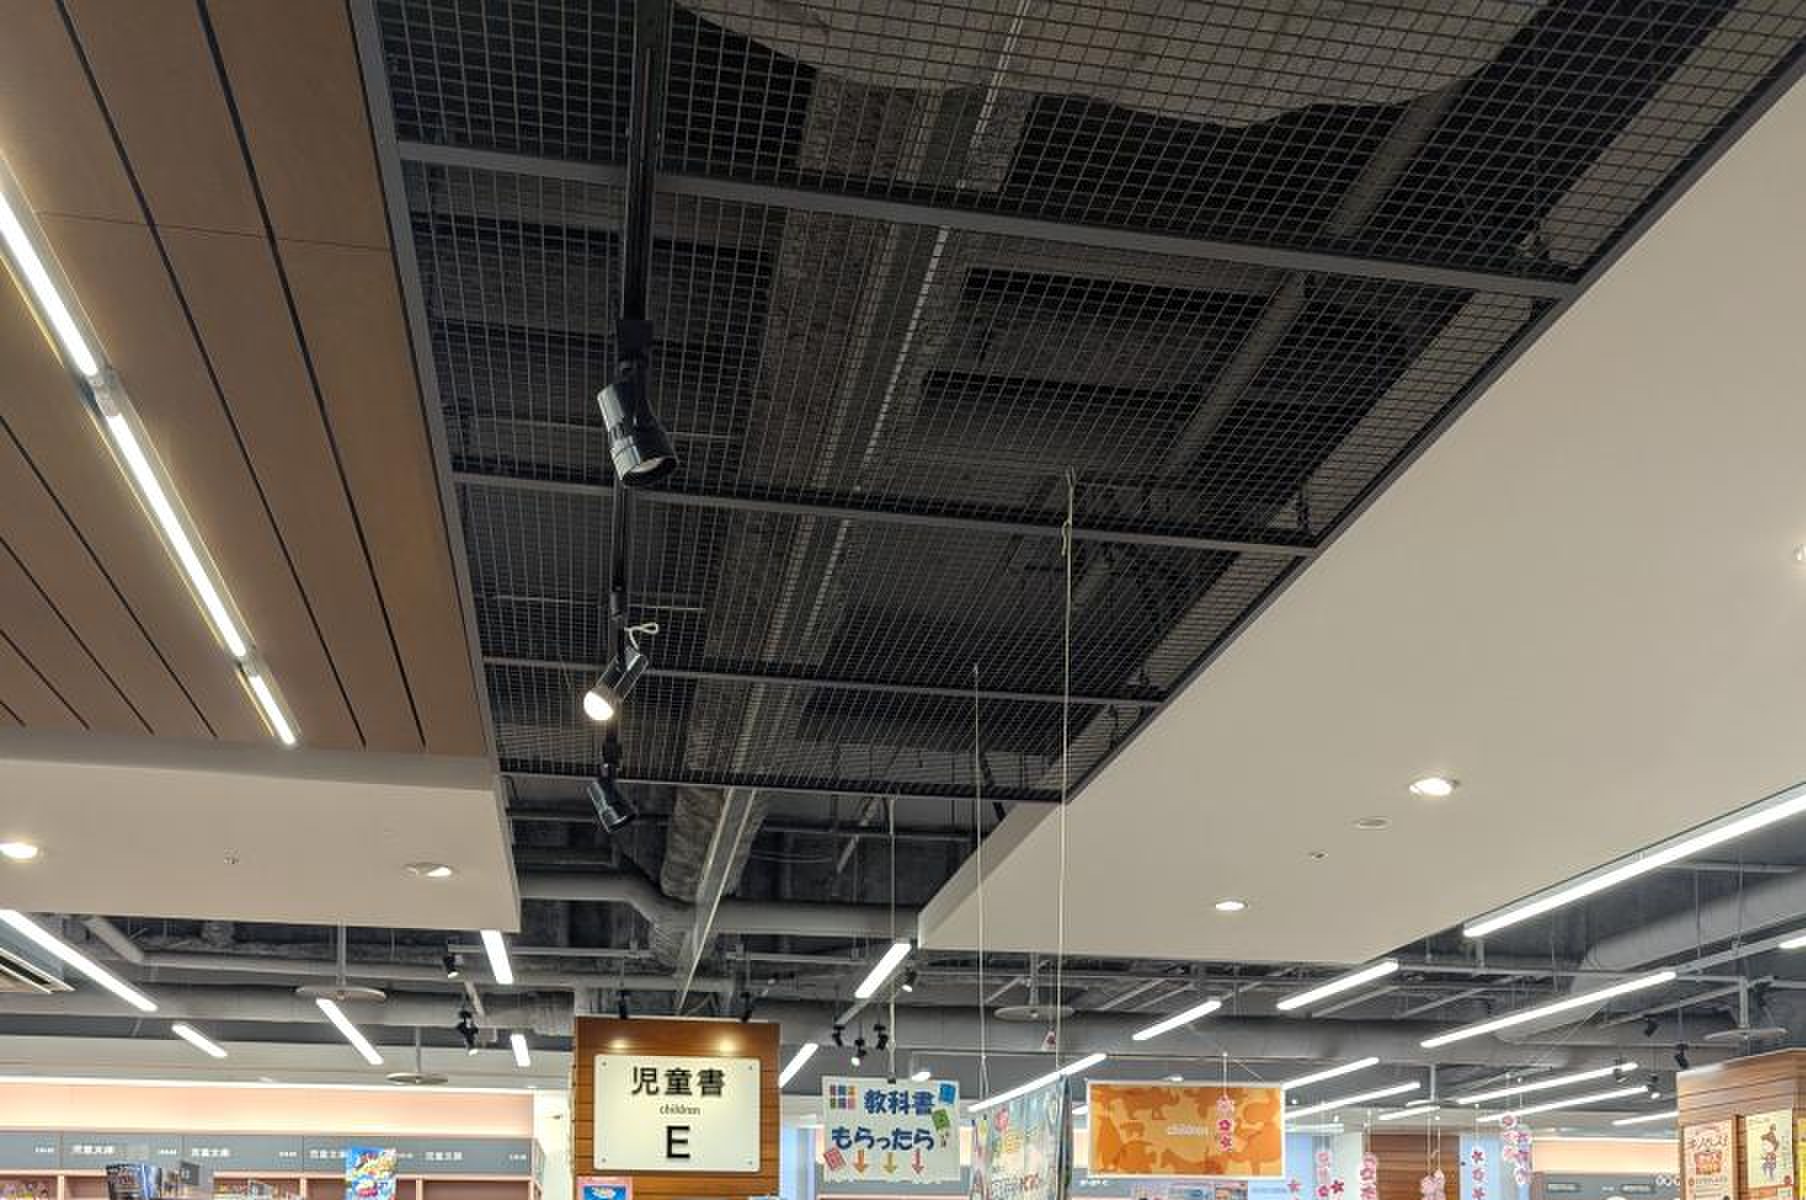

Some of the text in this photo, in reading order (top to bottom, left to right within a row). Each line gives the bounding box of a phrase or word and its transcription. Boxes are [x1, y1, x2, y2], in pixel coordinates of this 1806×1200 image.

[632, 1065, 726, 1098] 児童書
[658, 1103, 701, 1116] children
[863, 1088, 936, 1115] 教科書
[665, 1124, 691, 1159] E
[831, 1125, 935, 1151] もらったら
